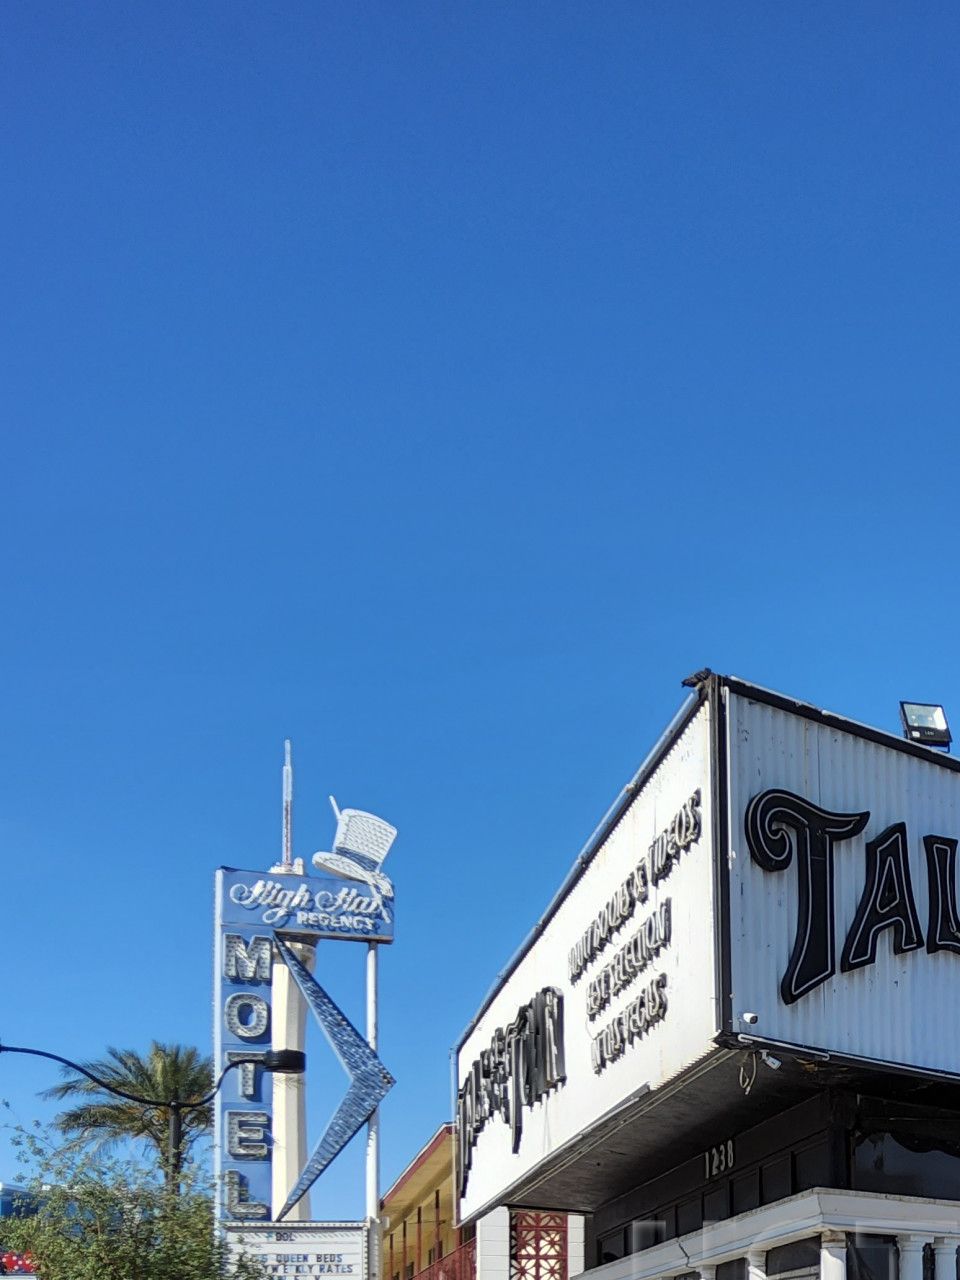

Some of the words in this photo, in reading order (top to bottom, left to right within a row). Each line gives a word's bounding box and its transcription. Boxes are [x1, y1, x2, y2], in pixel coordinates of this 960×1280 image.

[647, 787, 702, 889] VIDEOS
[229, 880, 310, 923] High
[297, 911, 375, 930] REGENCY
[223, 932, 273, 1217] MOTEL
[704, 1139, 735, 1179] 1238
[275, 1253, 309, 1263] QUEEN
[316, 1253, 343, 1263] BEDS
[318, 1263, 354, 1274] RATES
